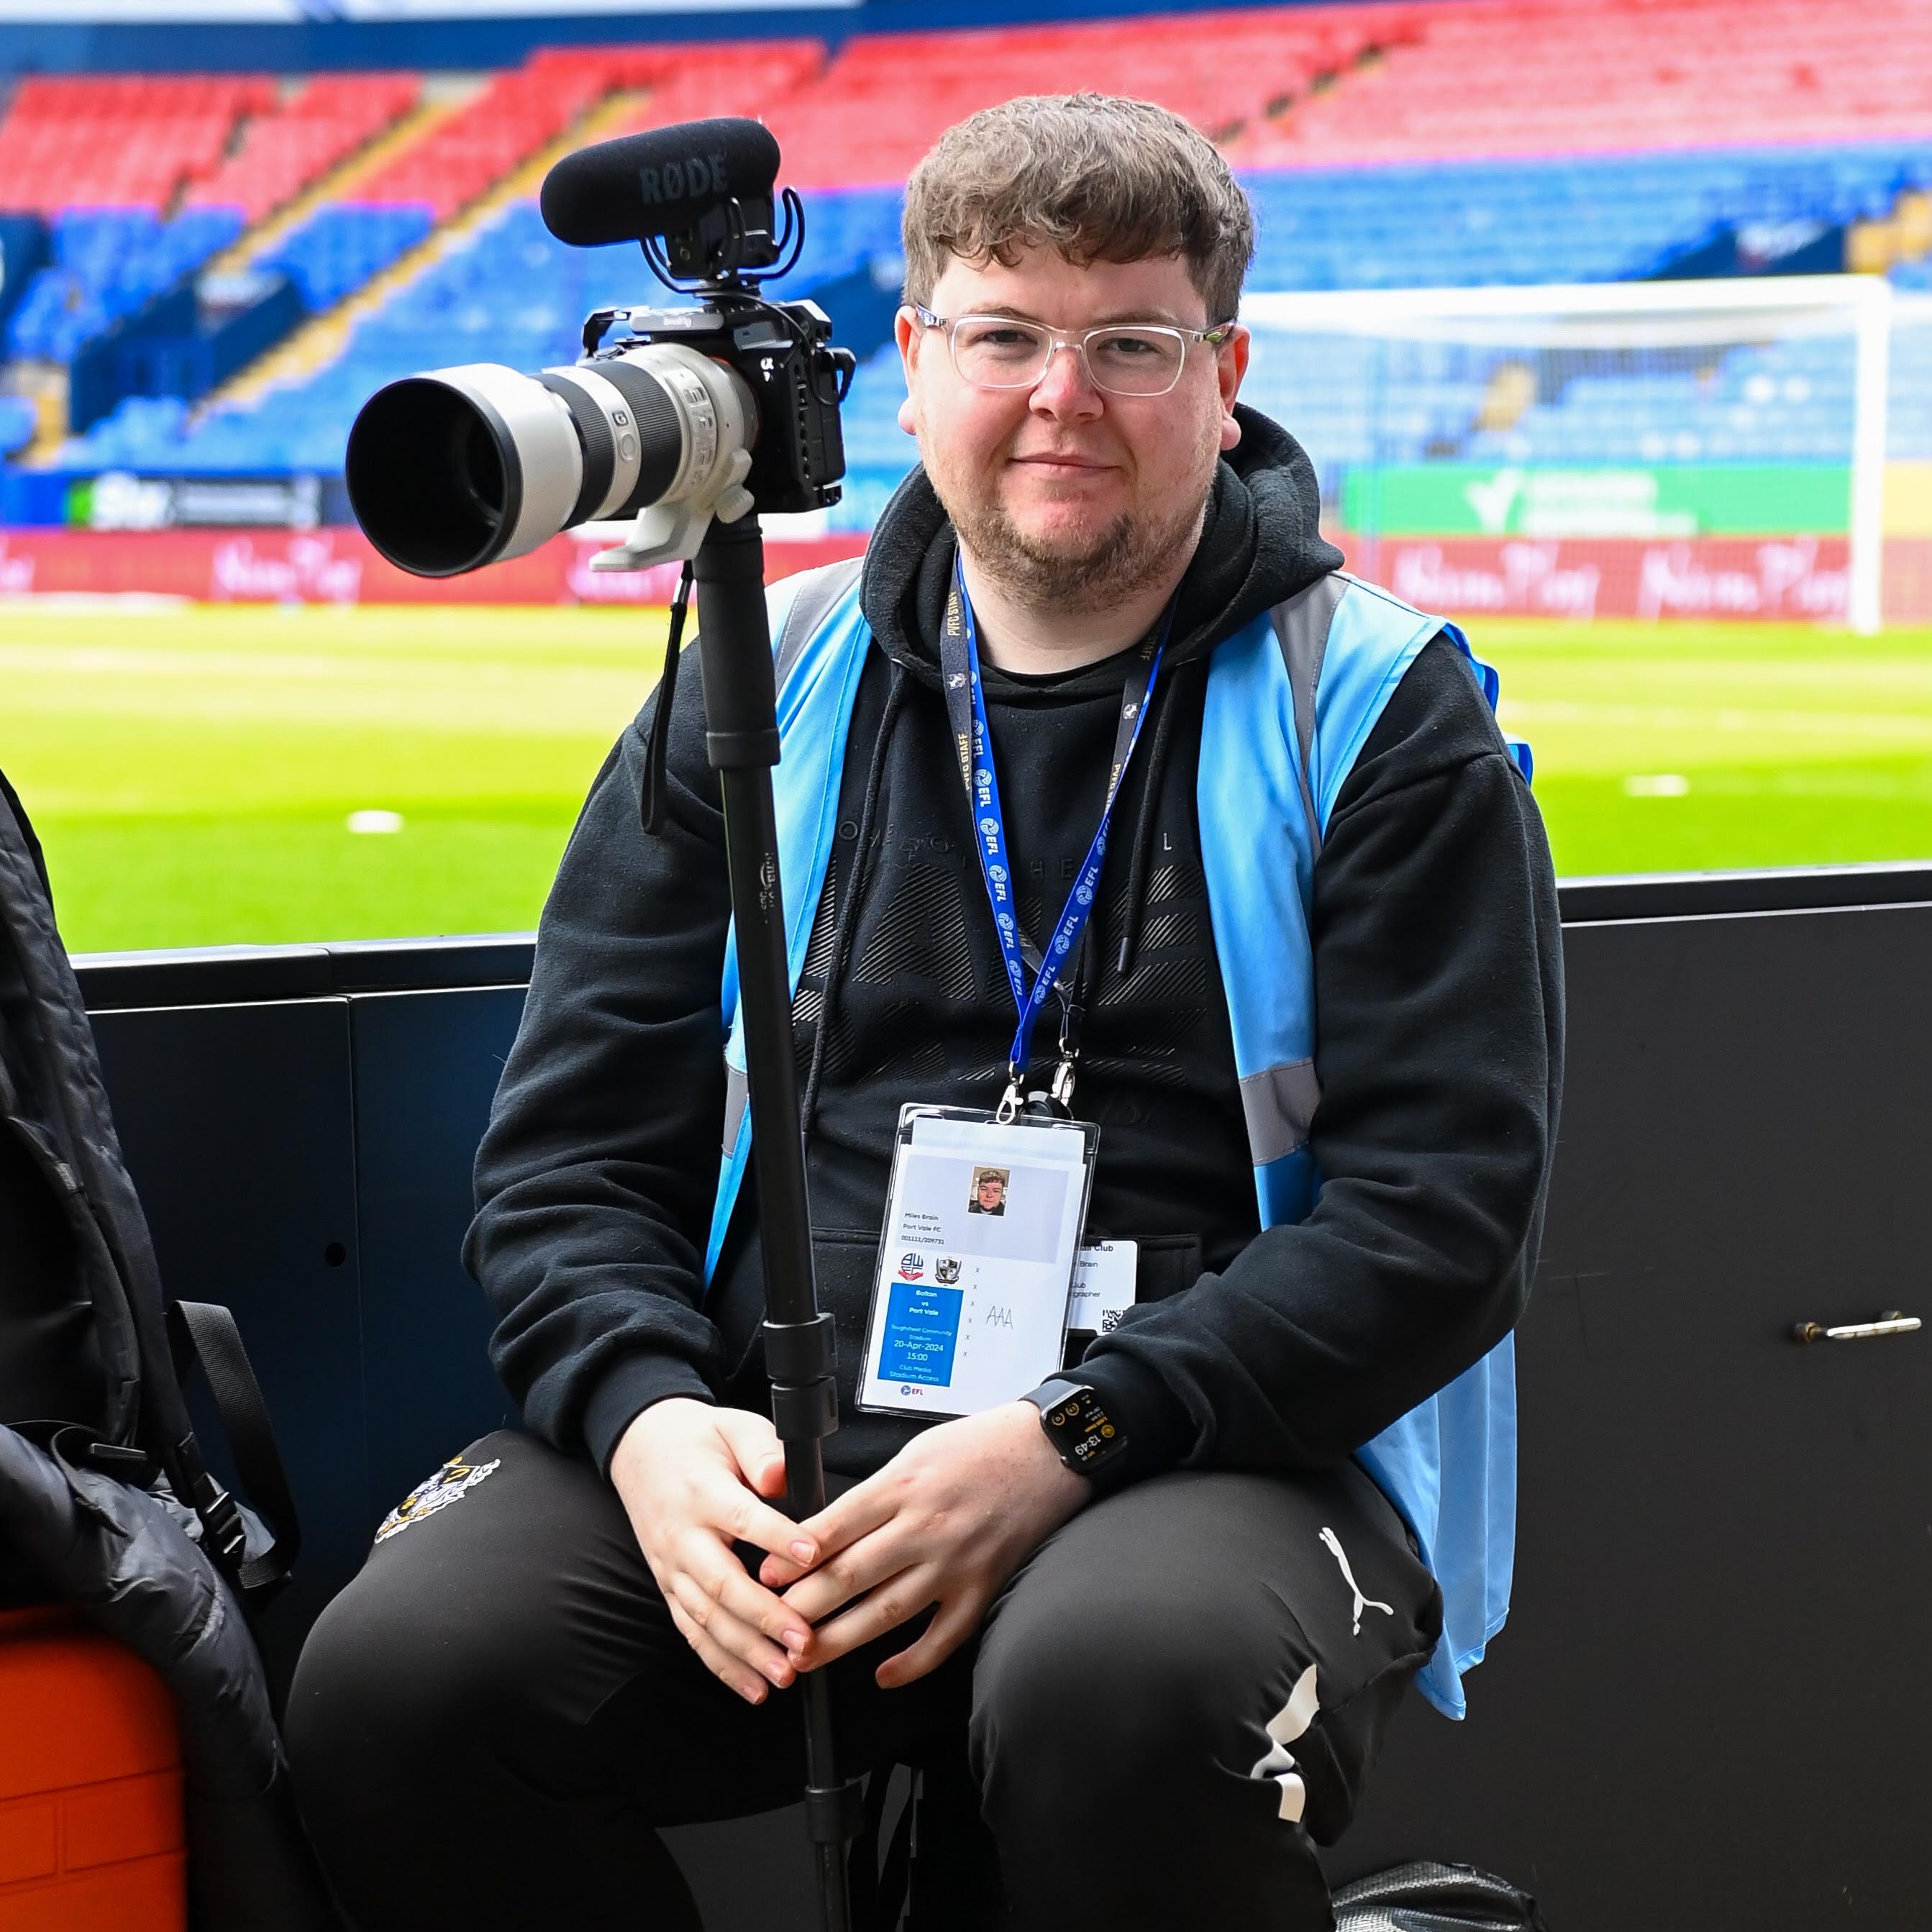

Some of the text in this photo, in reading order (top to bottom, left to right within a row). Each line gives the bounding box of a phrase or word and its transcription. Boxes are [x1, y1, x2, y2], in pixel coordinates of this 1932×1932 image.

[639, 154, 729, 205] RØDE
[978, 787, 991, 808] EFL
[985, 836, 999, 855] EFL
[1085, 866, 1099, 888] EFL
[995, 883, 1007, 902] EFL
[1062, 916, 1079, 937] EFL
[1003, 930, 1015, 949] EFL
[1042, 966, 1056, 986] EFL
[893, 1339, 944, 1352] 20-Apr-2024
[907, 1352, 929, 1361] 15:00
[1075, 1434, 1101, 1455] 13:49
